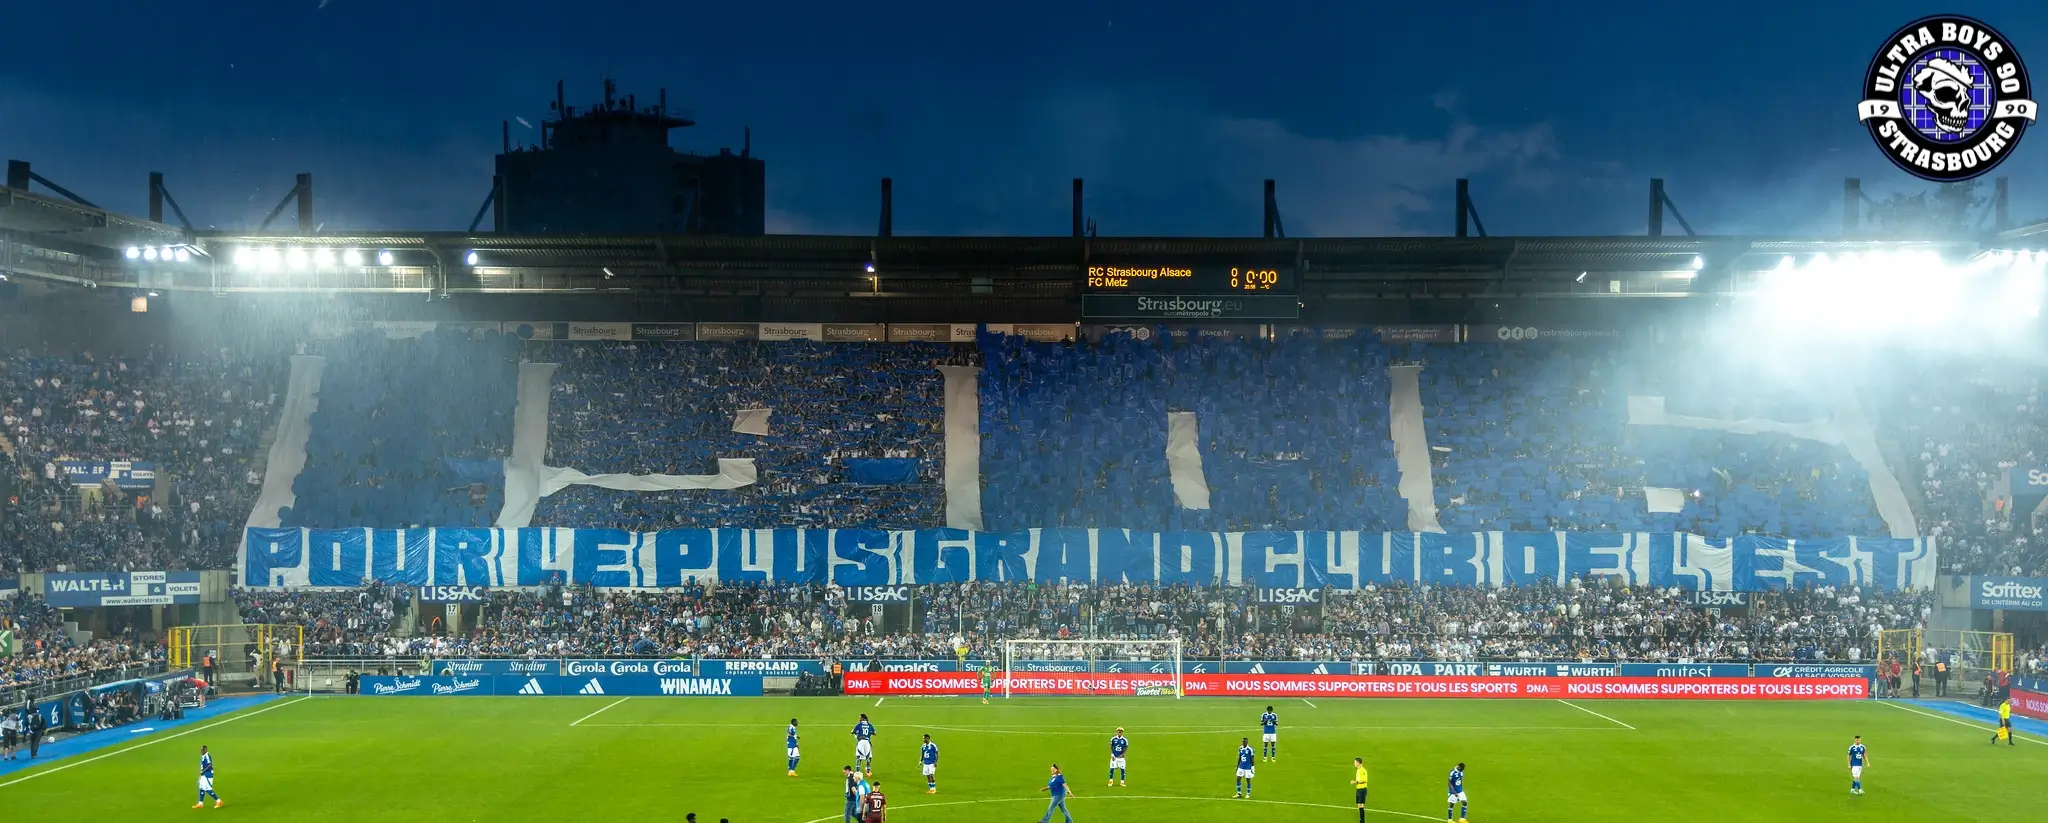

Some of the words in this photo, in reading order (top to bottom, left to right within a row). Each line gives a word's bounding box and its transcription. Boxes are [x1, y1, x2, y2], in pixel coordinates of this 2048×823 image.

[1088, 268, 1104, 277] RC
[1107, 267, 1157, 278] Strasbourg
[1160, 268, 1192, 277] Alsace
[1231, 268, 1238, 277] 0
[1088, 278, 1103, 287] FC
[1105, 278, 1128, 287] Metz
[1231, 278, 1238, 287] 0
[246, 527, 493, 587] POUR
[517, 527, 632, 588] LE
[655, 528, 892, 586] PLUS
[912, 528, 1218, 586] GRAND
[1243, 531, 1479, 590] CLUB
[1500, 532, 1626, 590] DE
[51, 579, 125, 592] WALTER
[1982, 581, 2042, 599] Sofitex
[421, 586, 482, 600] LISSAC
[848, 586, 908, 601] LISSAC
[1259, 588, 1319, 603] LISSAC
[1687, 591, 1746, 605] LISSAC
[106, 597, 169, 605] www.walter-stores.fr
[448, 604, 456, 612] 17
[873, 604, 882, 613] 18
[1285, 606, 1293, 614] 19
[447, 660, 483, 671] Stradim
[509, 661, 547, 672] Stradim
[567, 661, 606, 675] Carola
[610, 661, 648, 675] Carola
[653, 661, 691, 675] Carola
[725, 661, 799, 670] REPROLAND
[1358, 663, 1423, 675] EUOPA
[1434, 664, 1478, 676] PARK
[1656, 666, 1712, 677] mutest
[374, 682, 395, 694] Pierre
[395, 678, 421, 691] Schmidt
[432, 682, 453, 694] Pierre
[453, 678, 479, 691] Schmidt
[661, 678, 732, 695] WINAMAX
[848, 680, 869, 689] DNA
[889, 679, 923, 689] NOUS
[925, 679, 978, 689] SOMMES
[1058, 680, 1072, 689] DE
[1075, 680, 1107, 690] TOUS
[1109, 680, 1128, 690] LES
[1186, 681, 1207, 690] DNA
[1226, 680, 1261, 691] NOUS
[1263, 681, 1316, 691] SOMMES
[1318, 681, 1395, 692] SUPPORTERS
[1397, 682, 1412, 692] DE
[1414, 682, 1447, 693] TOUS
[1449, 683, 1468, 693] LES
[1470, 683, 1518, 693] SPORTS
[1526, 684, 1548, 693] DNA
[1568, 683, 1603, 694] NOUS
[1605, 683, 1659, 694] SOMMES
[1661, 684, 1738, 695] SUPPORTERS
[1741, 684, 1756, 695] DE
[1758, 685, 1791, 695] TOUS
[1793, 685, 1813, 695] LES
[1815, 685, 1863, 695] SPORTS
[1137, 687, 1160, 696] Tourtel
[873, 799, 881, 809] 10
